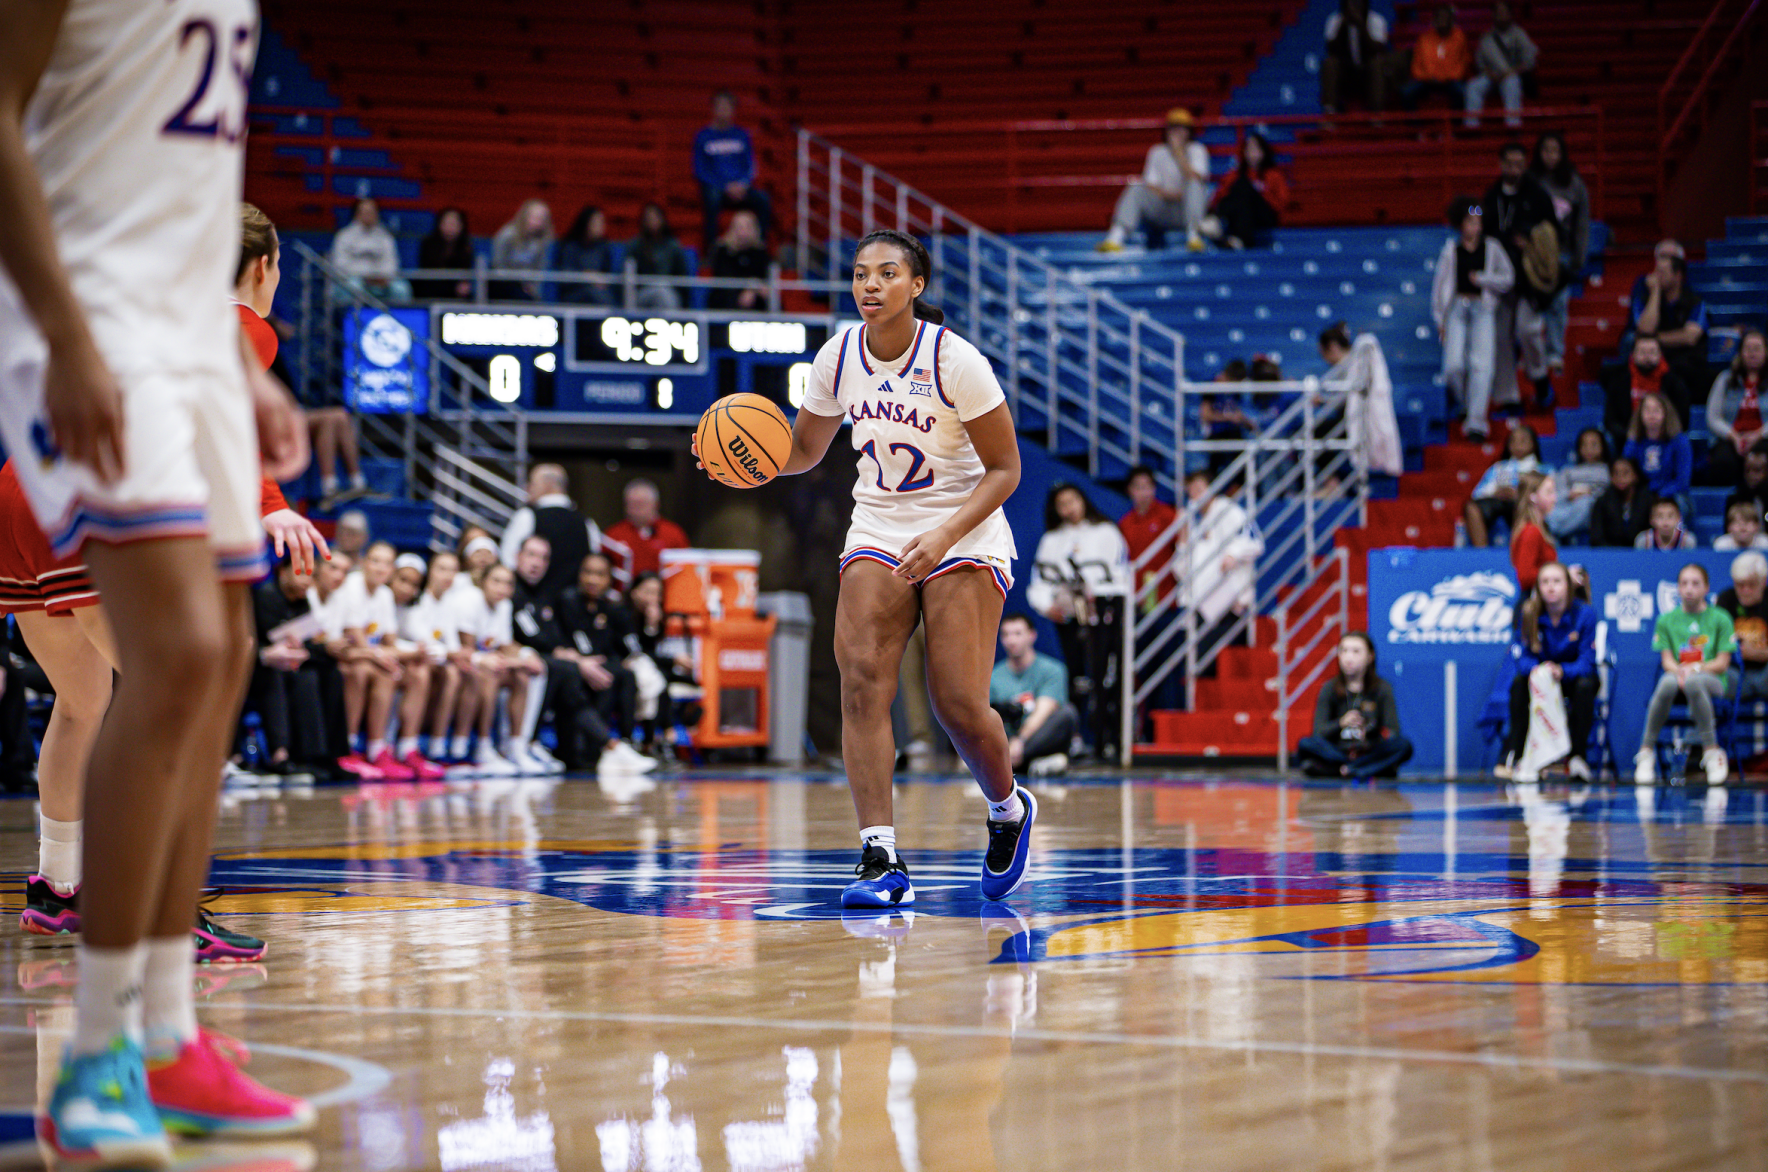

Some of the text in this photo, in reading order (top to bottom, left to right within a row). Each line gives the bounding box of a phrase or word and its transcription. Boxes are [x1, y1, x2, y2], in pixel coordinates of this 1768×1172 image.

[602, 316, 699, 365] 9:34
[490, 355, 521, 403] 0
[849, 400, 936, 433] KANSAS
[728, 435, 769, 483] Wilson
[861, 439, 934, 492] 12
[1389, 590, 1514, 632] Club
